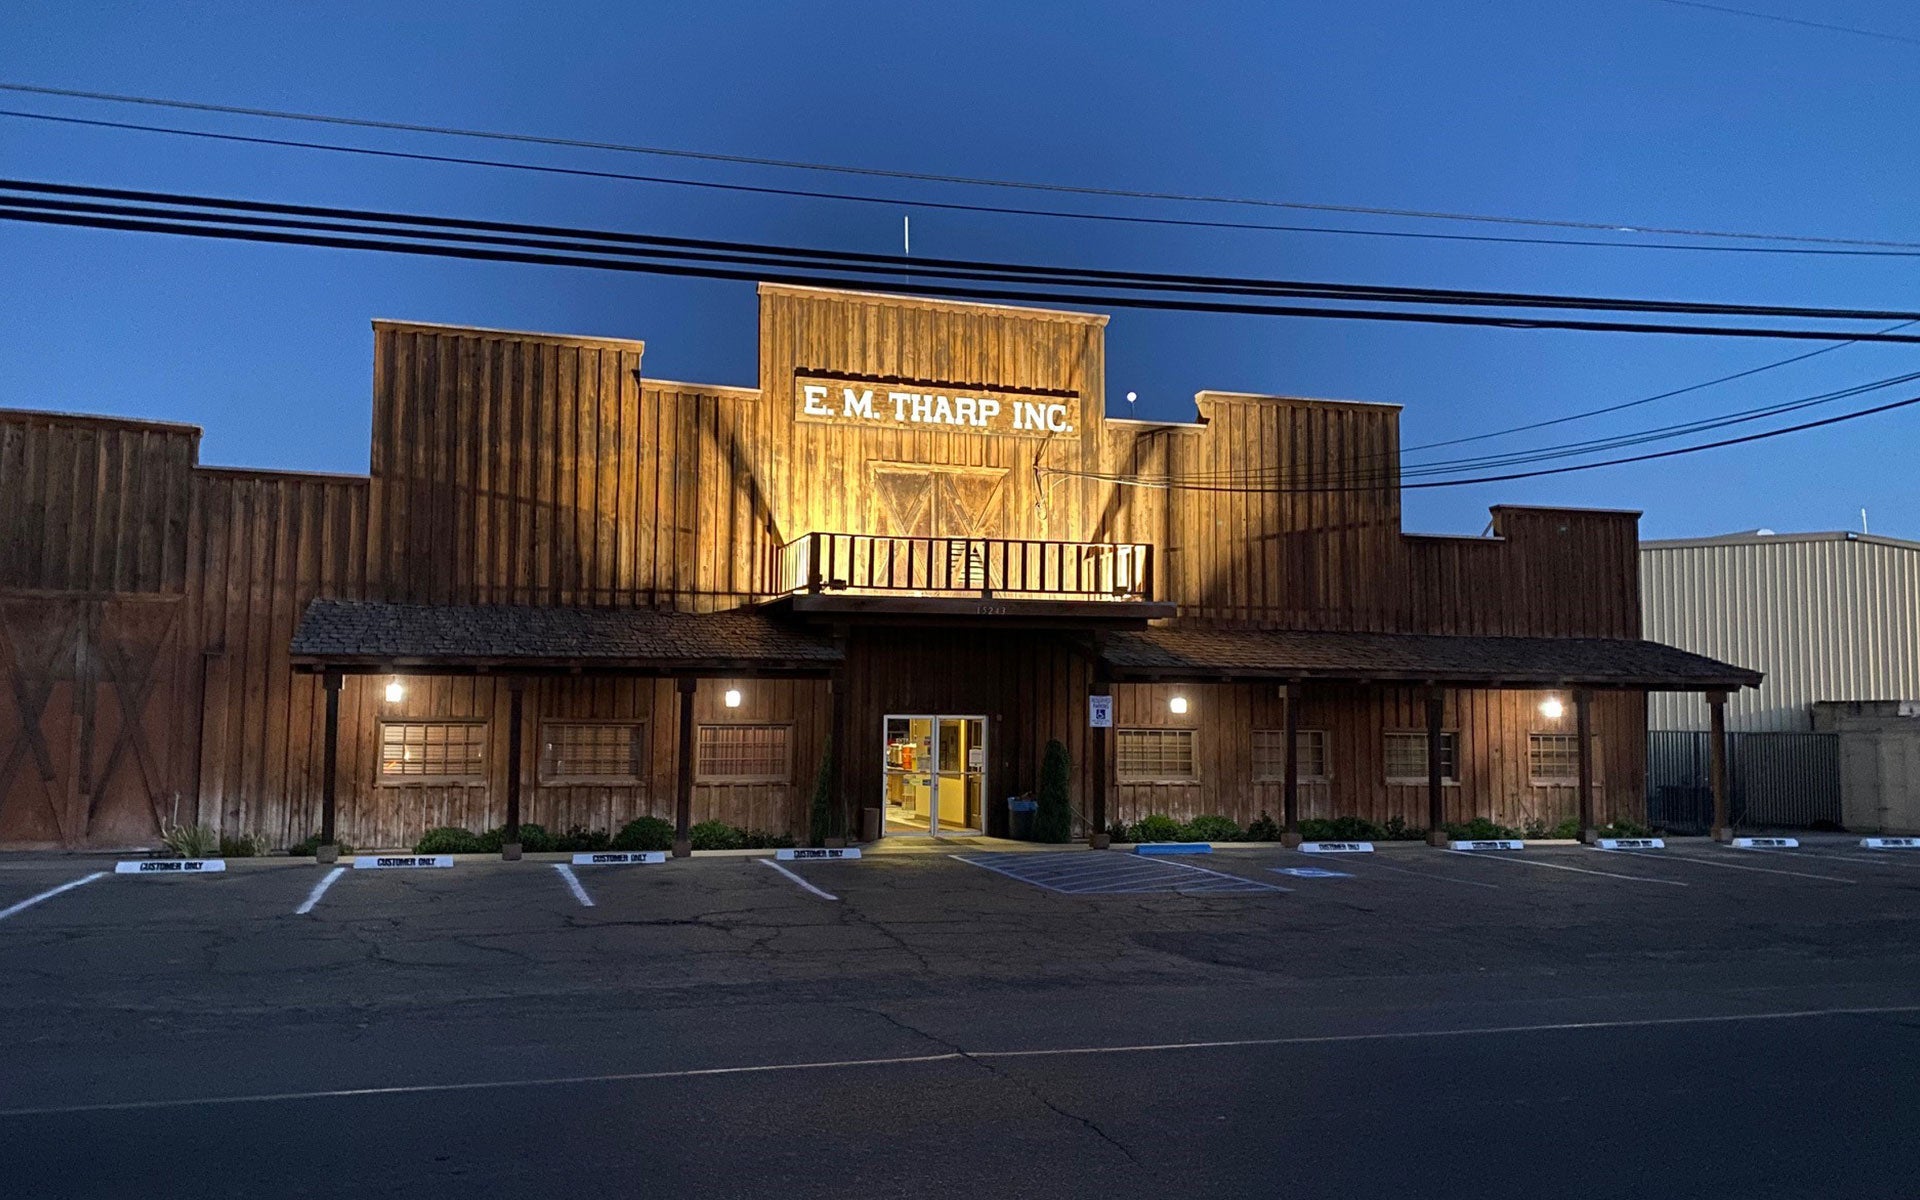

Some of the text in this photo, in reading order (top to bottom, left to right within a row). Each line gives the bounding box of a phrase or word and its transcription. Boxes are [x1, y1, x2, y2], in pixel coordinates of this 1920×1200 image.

[804, 385, 1073, 432] E. M. THARP INC.
[377, 858, 436, 867] CUSTOMER ONLY
[592, 854, 628, 863] CUSTOMER
[139, 862, 204, 871] CUSTOMER ONLY
